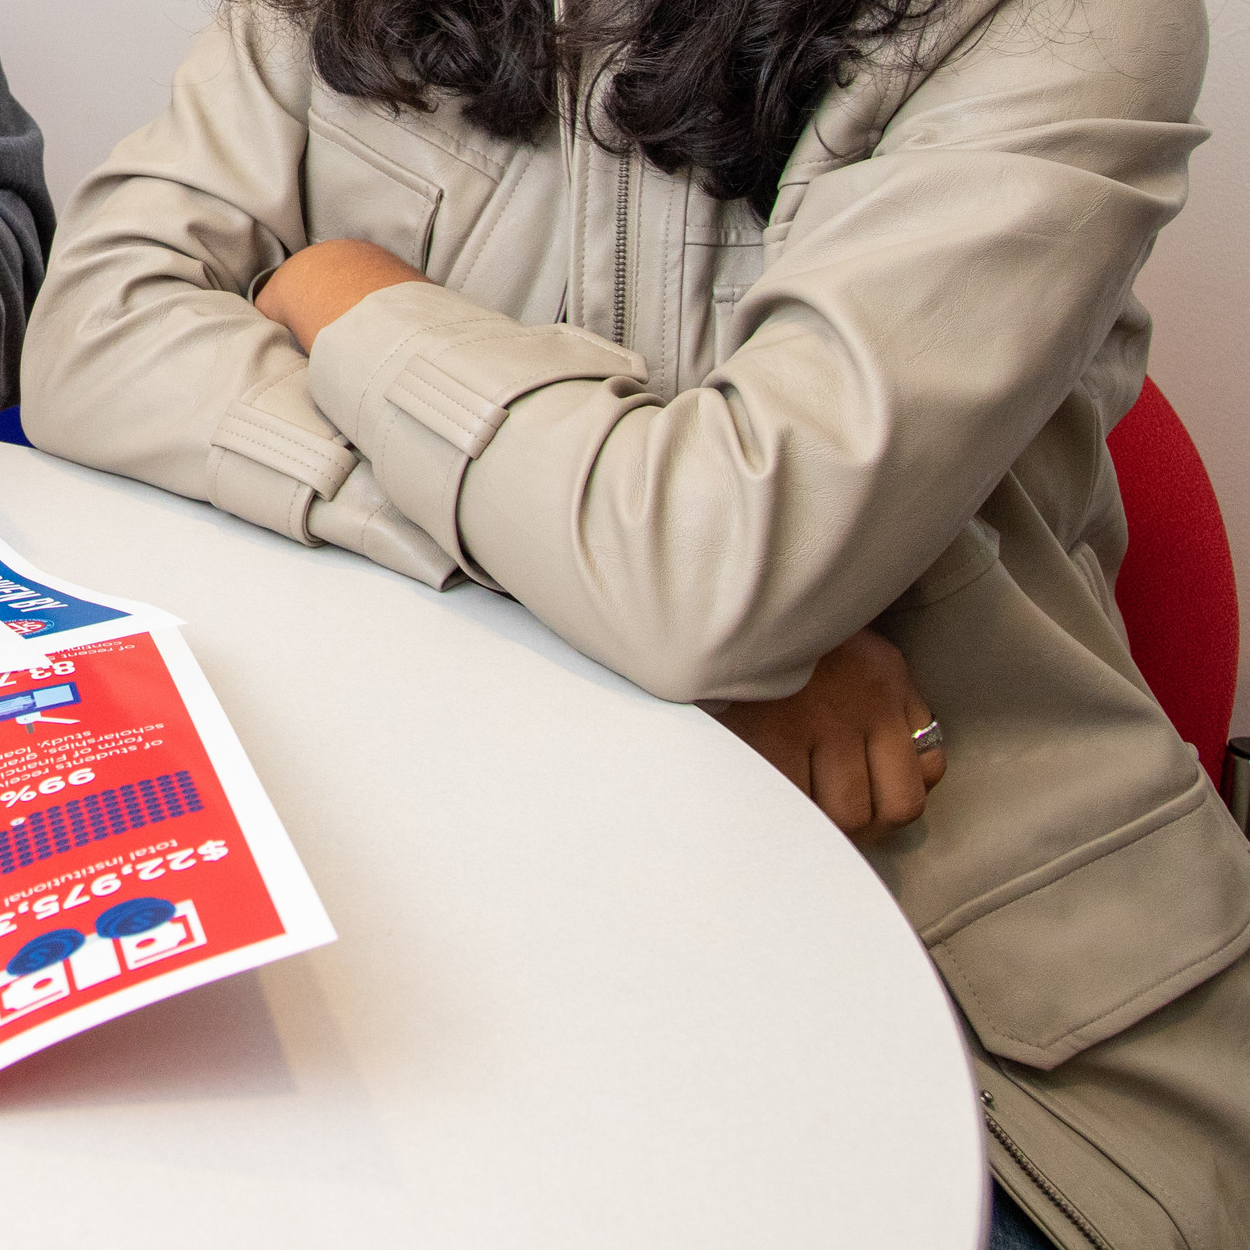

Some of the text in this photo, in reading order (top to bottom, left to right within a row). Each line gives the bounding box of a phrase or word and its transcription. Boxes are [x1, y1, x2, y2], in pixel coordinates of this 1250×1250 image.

[8, 597, 68, 613] BY
[36, 730, 92, 748] study,
[98, 735, 143, 750] form
[144, 738, 164, 750] of
[54, 746, 138, 770] students
[73, 747, 92, 758] of
[0, 768, 96, 808] 99%
[129, 838, 178, 860] total
[4, 856, 124, 907] institutional
